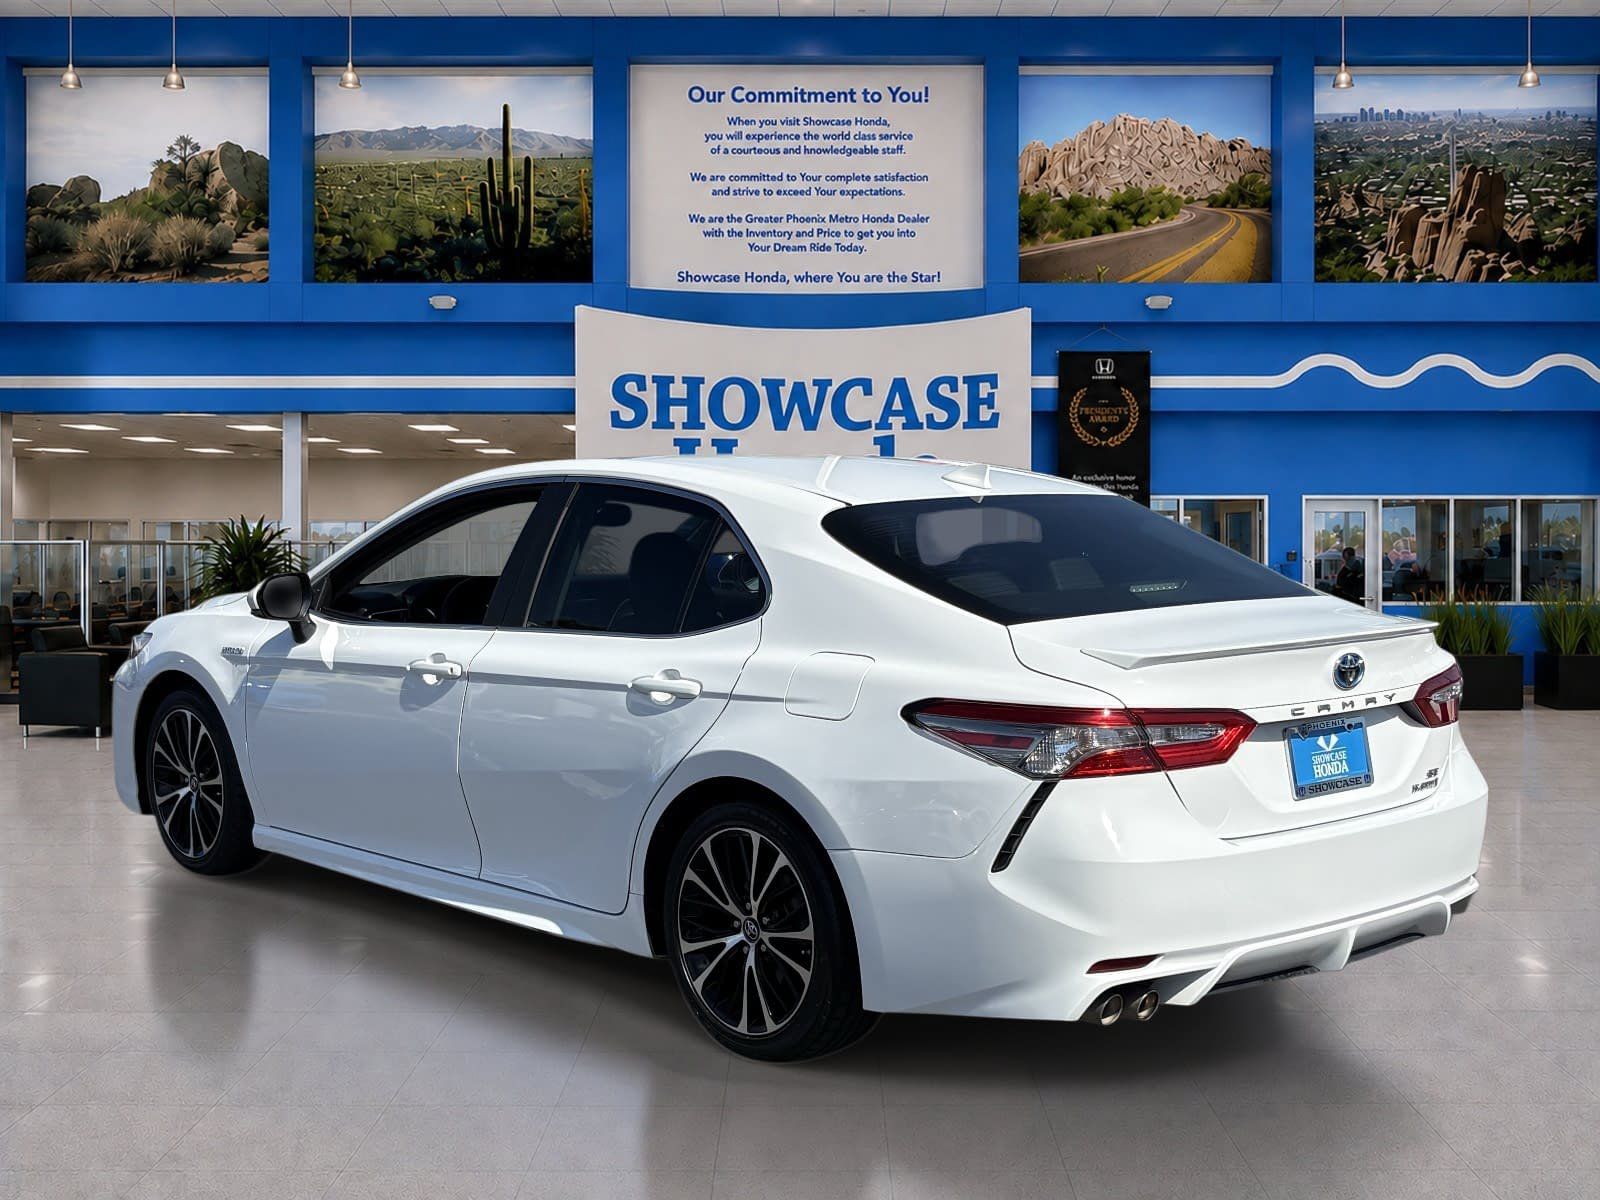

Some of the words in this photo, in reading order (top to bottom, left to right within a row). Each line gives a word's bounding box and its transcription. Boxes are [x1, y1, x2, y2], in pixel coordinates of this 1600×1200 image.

[687, 85, 726, 104] Our
[730, 85, 857, 104] Commitment
[861, 87, 883, 104] to
[886, 85, 929, 104] You!
[726, 116, 757, 127] When
[758, 118, 778, 129] you
[779, 116, 801, 127] visit
[802, 116, 853, 127] Showcase
[854, 116, 891, 128] Honda,
[704, 133, 724, 144] you
[725, 130, 743, 141] will
[745, 130, 801, 144] experience
[802, 130, 820, 141] the
[822, 130, 851, 141] world
[852, 130, 877, 141] class
[878, 130, 914, 141] service
[710, 144, 721, 155] of
[722, 147, 730, 155] a
[730, 146, 781, 155] courteous
[782, 144, 802, 155] and
[881, 144, 906, 155] staff.
[689, 172, 707, 182] We
[709, 174, 726, 182] are
[728, 171, 784, 183] committed
[786, 173, 798, 182] to
[799, 172, 823, 183] Your
[824, 172, 872, 185] complete
[873, 171, 929, 183] satisfaction
[711, 186, 731, 197] and
[732, 186, 761, 197] strive
[762, 187, 774, 197] to
[775, 186, 812, 197] exceed
[814, 186, 838, 197] Your
[839, 186, 906, 200] expectations.
[688, 213, 706, 224] We
[707, 216, 725, 224] are
[725, 213, 743, 224] the
[744, 213, 785, 224] Greater
[785, 213, 827, 224] Phoenix
[828, 213, 860, 224] Metro
[861, 213, 895, 224] Honda
[897, 213, 931, 224] Dealer
[702, 227, 725, 238] with
[726, 227, 744, 238] the
[745, 227, 794, 241] Inventory
[795, 227, 815, 238] and
[816, 227, 842, 239] Price
[843, 229, 855, 238] to
[856, 229, 875, 241] get
[876, 230, 895, 241] you
[896, 227, 917, 238] into
[747, 242, 772, 253] Your
[773, 242, 808, 253] Dream
[809, 242, 833, 253] Ride
[834, 242, 867, 255] Today.
[677, 270, 741, 284] Showcase
[744, 270, 790, 285] Honda,
[793, 271, 834, 284] where
[836, 271, 861, 284] You
[863, 274, 884, 284] are
[886, 270, 908, 283] the
[911, 271, 941, 284] Star!
[609, 372, 1001, 432] SHOWCASE
[1290, 692, 1397, 717] CAMRY
[1307, 719, 1346, 731] PHOENIX
[1311, 750, 1348, 764] SHOWCASE
[1312, 760, 1350, 779] HONDA
[1308, 776, 1363, 795] SHOWCASE
